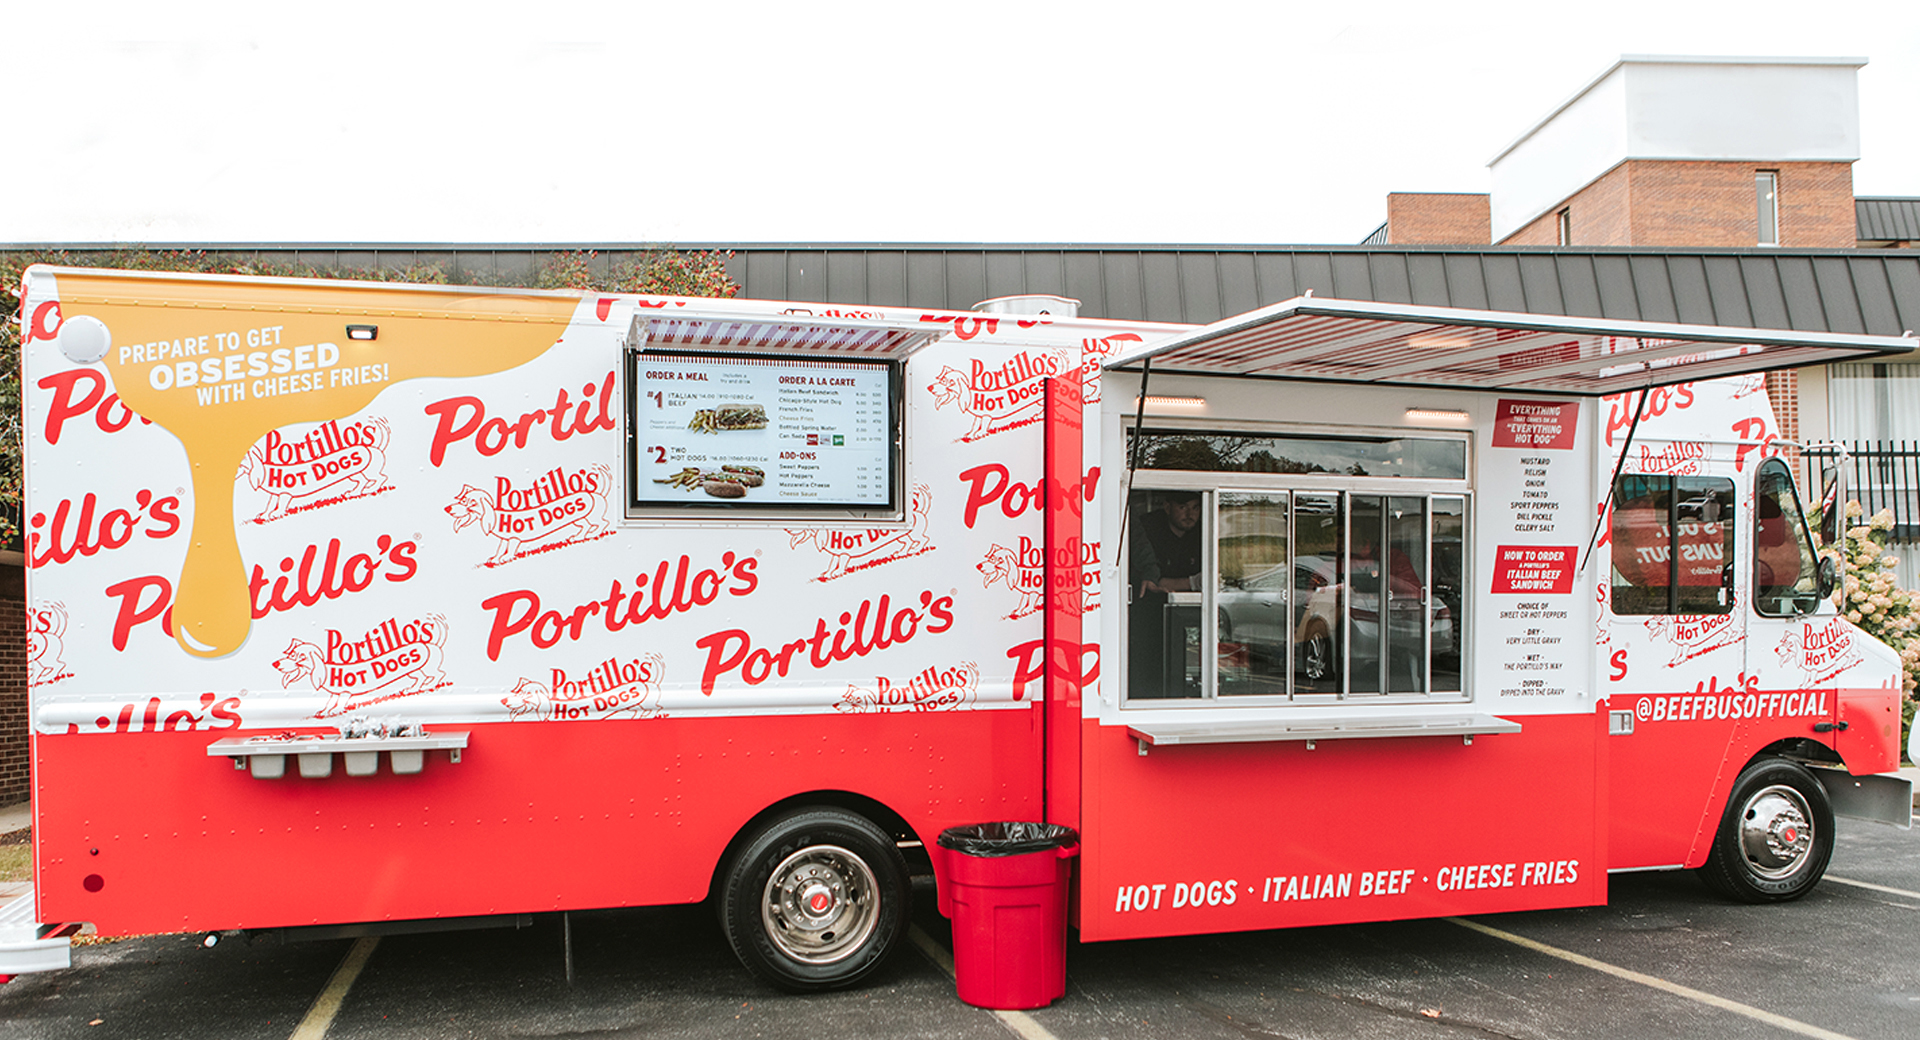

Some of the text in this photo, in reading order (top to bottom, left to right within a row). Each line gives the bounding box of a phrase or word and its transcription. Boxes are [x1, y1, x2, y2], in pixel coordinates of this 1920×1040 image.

[119, 325, 283, 365] PREPARE TO GET
[149, 342, 339, 391] OBSESSED
[969, 351, 1058, 391] Portillo's
[646, 370, 709, 382] ORDER A MEAL
[779, 375, 856, 387] ORDER A LA CARTE
[196, 363, 390, 407] WITH CHEESE FRIES!
[647, 391, 663, 409] #1
[973, 392, 1005, 412] HOT
[1510, 404, 1561, 416] EVERYTHING
[265, 418, 376, 466] Portillo's
[1515, 434, 1532, 444] HOT
[647, 446, 667, 464] #2
[779, 451, 817, 460] ADD-ONS
[1520, 457, 1550, 466] MUSTARD
[268, 451, 363, 488] HOT DOGS
[1524, 468, 1546, 477] RELISH
[494, 466, 599, 513] Portillo's
[1525, 479, 1546, 488] ONION
[1522, 490, 1548, 499] TOMATO
[1510, 501, 1560, 511] SPORT PEPPERS
[499, 498, 587, 534] HOT DOGS
[1516, 512, 1553, 521] DILL PICKLE
[1514, 523, 1555, 532] CELERY SALT
[830, 530, 863, 550] HOT
[1504, 551, 1565, 561] HOW TO ORDER
[1506, 570, 1562, 580] ITALIAN BEEF
[1510, 580, 1554, 590] SANDWICH
[105, 533, 417, 653] Ptillo's
[481, 550, 758, 663] Portillo's
[1517, 602, 1549, 610] CHOICE OF
[1500, 611, 1568, 619] SWEET OR HOT PEPPERS
[1527, 628, 1541, 637] DRY
[1676, 625, 1698, 640] HOT
[1701, 614, 1731, 634] DOGS
[325, 617, 434, 667] Portillo's
[697, 590, 954, 697] Portillo's
[1522, 637, 1541, 645] LITTLE
[1542, 637, 1561, 645] GRAVY
[1527, 654, 1541, 662] WET
[1805, 651, 1826, 666] HOT
[329, 649, 422, 688] HOT DOGS
[1504, 663, 1563, 671] THE PORTILLO'S WAY
[550, 657, 652, 702] Portillo's
[876, 665, 967, 707] Portillo's
[1522, 680, 1544, 688] DIPPED
[1500, 688, 1565, 697] DIPPED INTO THE GRAVY
[554, 686, 641, 719] HOT DOGS
[1636, 692, 1829, 722] @BEEFBUSOFFICIAL
[1115, 860, 1579, 913] HOT DOGS ITALIAN BEEF CHEESE FRIES
